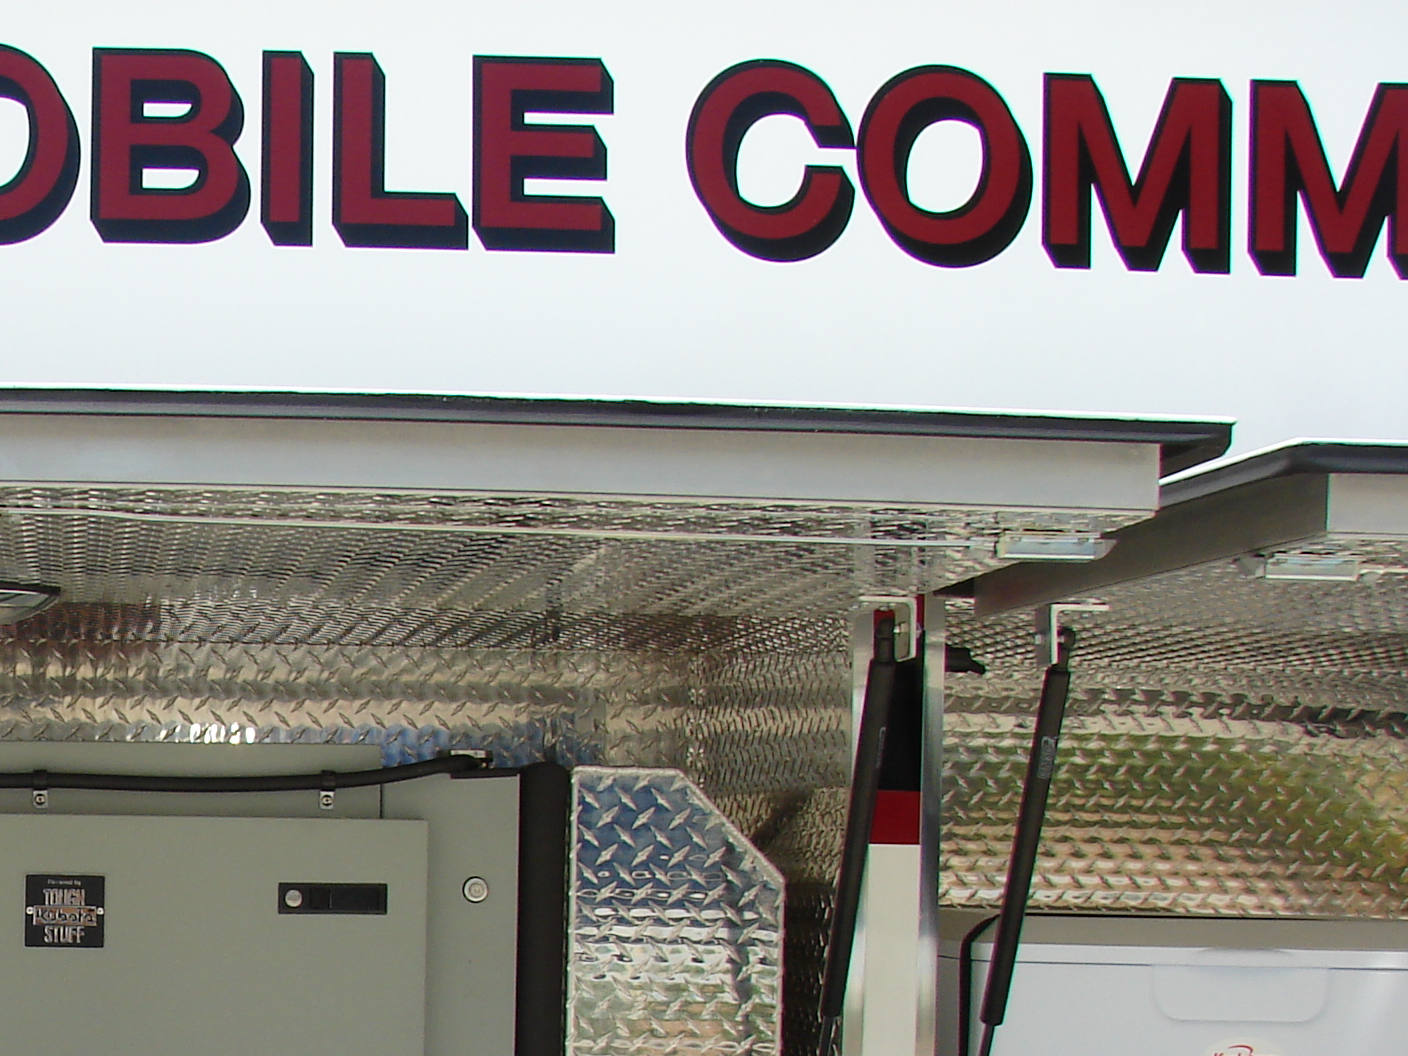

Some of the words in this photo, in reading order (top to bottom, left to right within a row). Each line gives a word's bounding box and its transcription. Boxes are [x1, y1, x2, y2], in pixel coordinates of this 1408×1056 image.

[686, 59, 1408, 280] COMM
[43, 888, 85, 906] TOUGH
[36, 907, 95, 924] Kubota
[44, 925, 84, 943] STUFF
